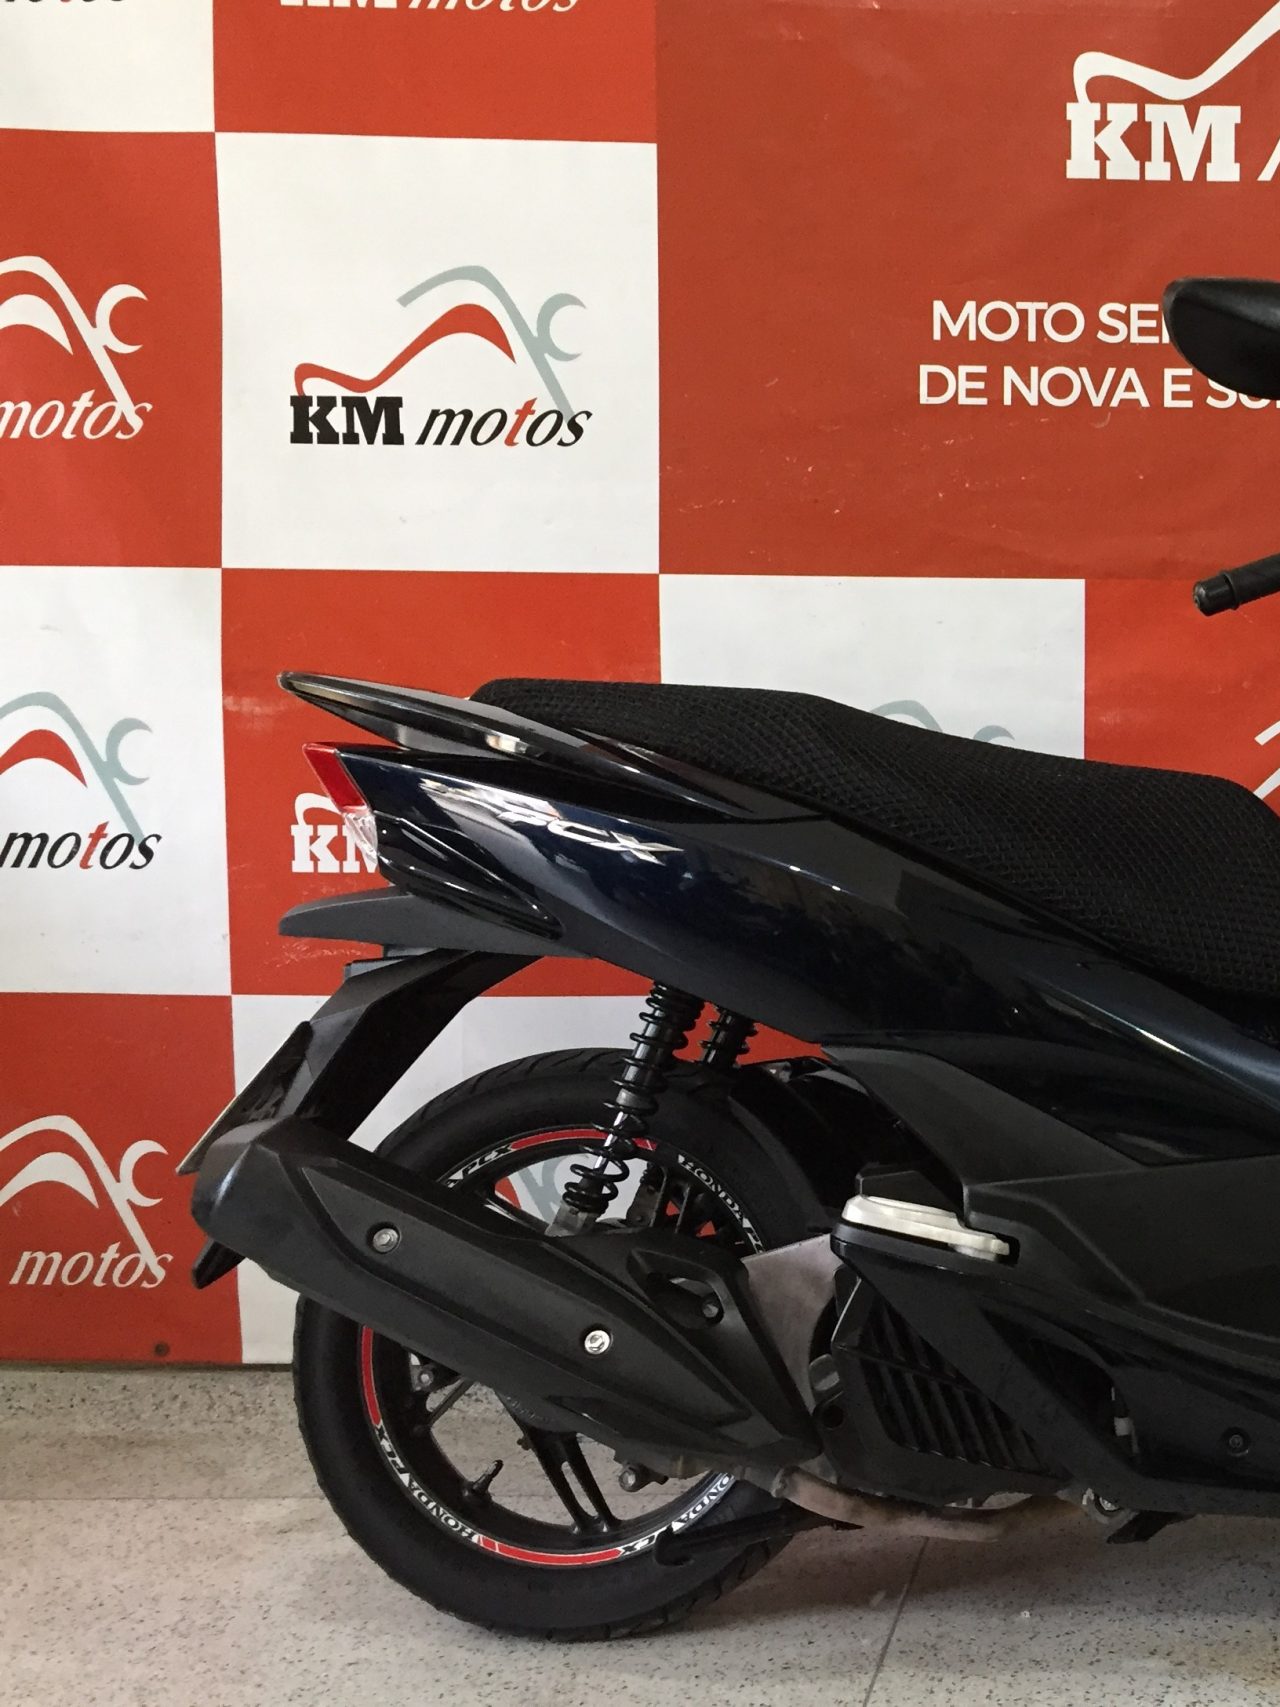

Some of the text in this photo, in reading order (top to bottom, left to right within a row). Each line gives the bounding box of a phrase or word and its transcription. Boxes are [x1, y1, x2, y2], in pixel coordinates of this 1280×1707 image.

[1065, 102, 1241, 182] KM
[933, 300, 1085, 343] MOTO
[919, 364, 988, 405] DE
[1003, 366, 1150, 407] NOVA
[1163, 368, 1194, 408] E
[290, 395, 593, 447] KM motos
[0, 821, 162, 870] motos
[9, 1241, 174, 1289] motos
[408, 1477, 477, 1542] HONDA
[674, 1473, 736, 1524] ONDA
